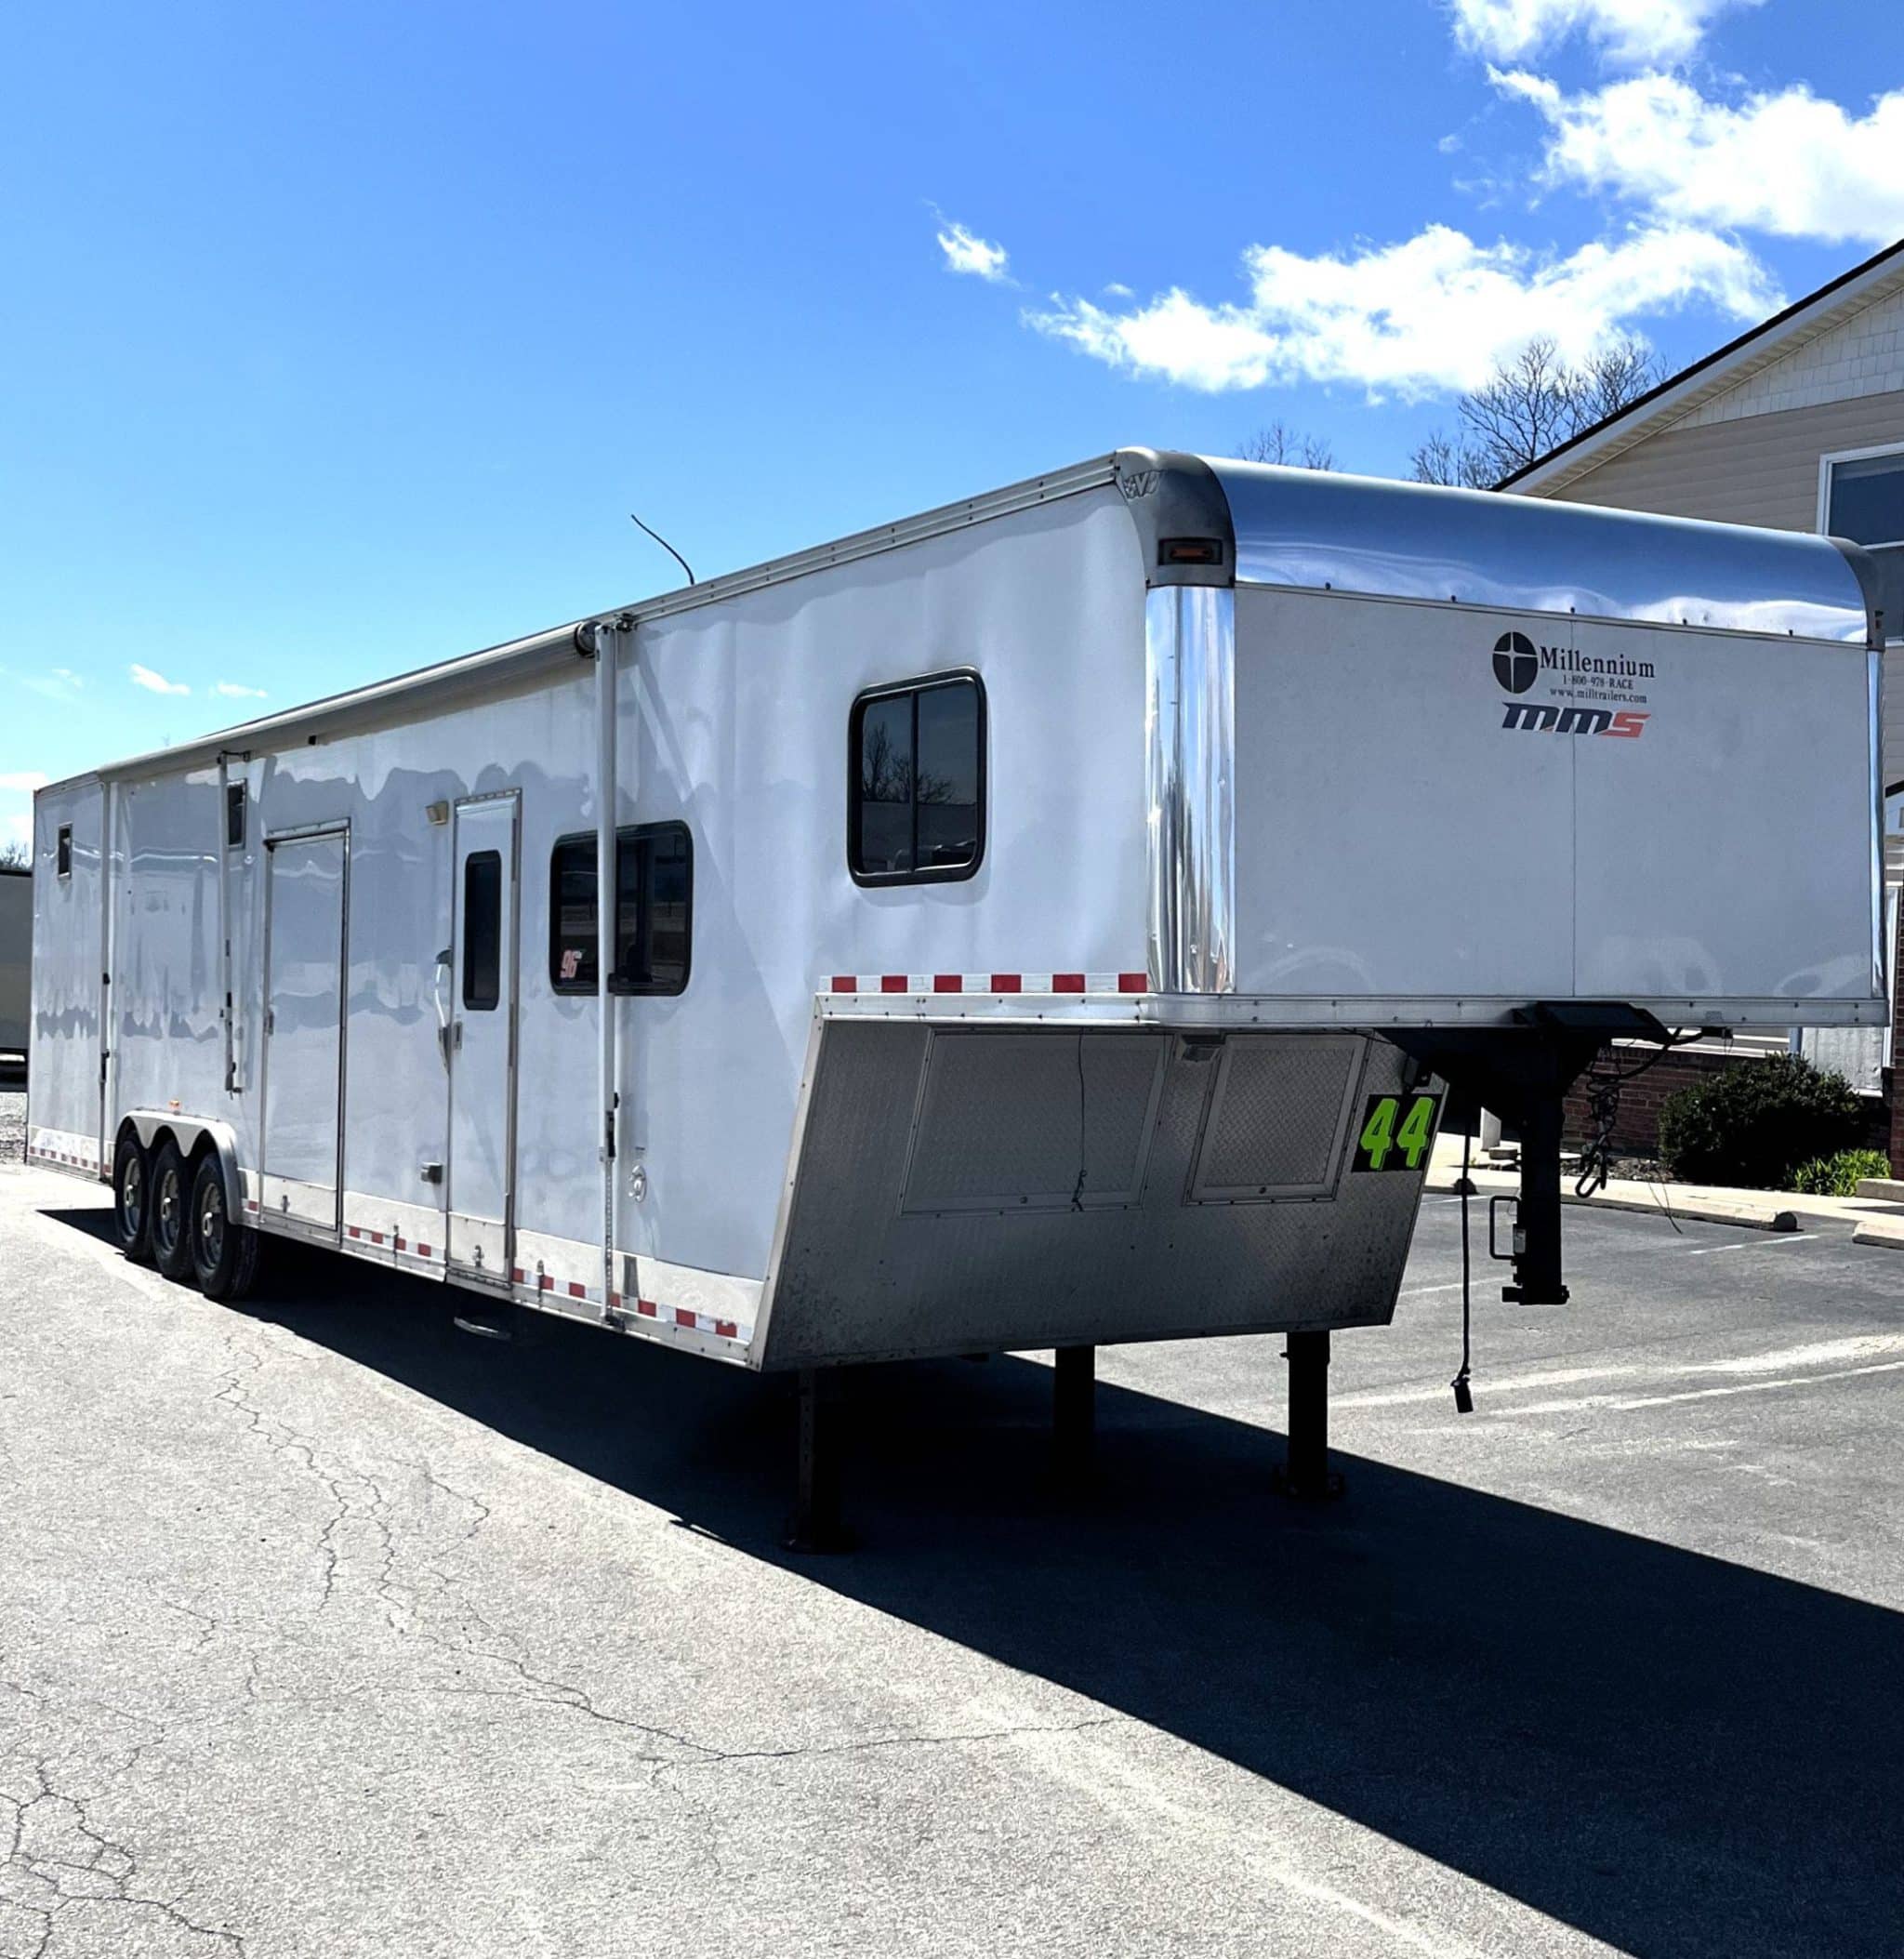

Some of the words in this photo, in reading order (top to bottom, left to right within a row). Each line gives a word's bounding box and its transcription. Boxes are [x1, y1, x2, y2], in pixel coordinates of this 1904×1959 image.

[1540, 646, 1655, 678] Millennium
[1550, 688, 1647, 704] www.milltrailers.com
[1360, 1097, 1435, 1171] 44
